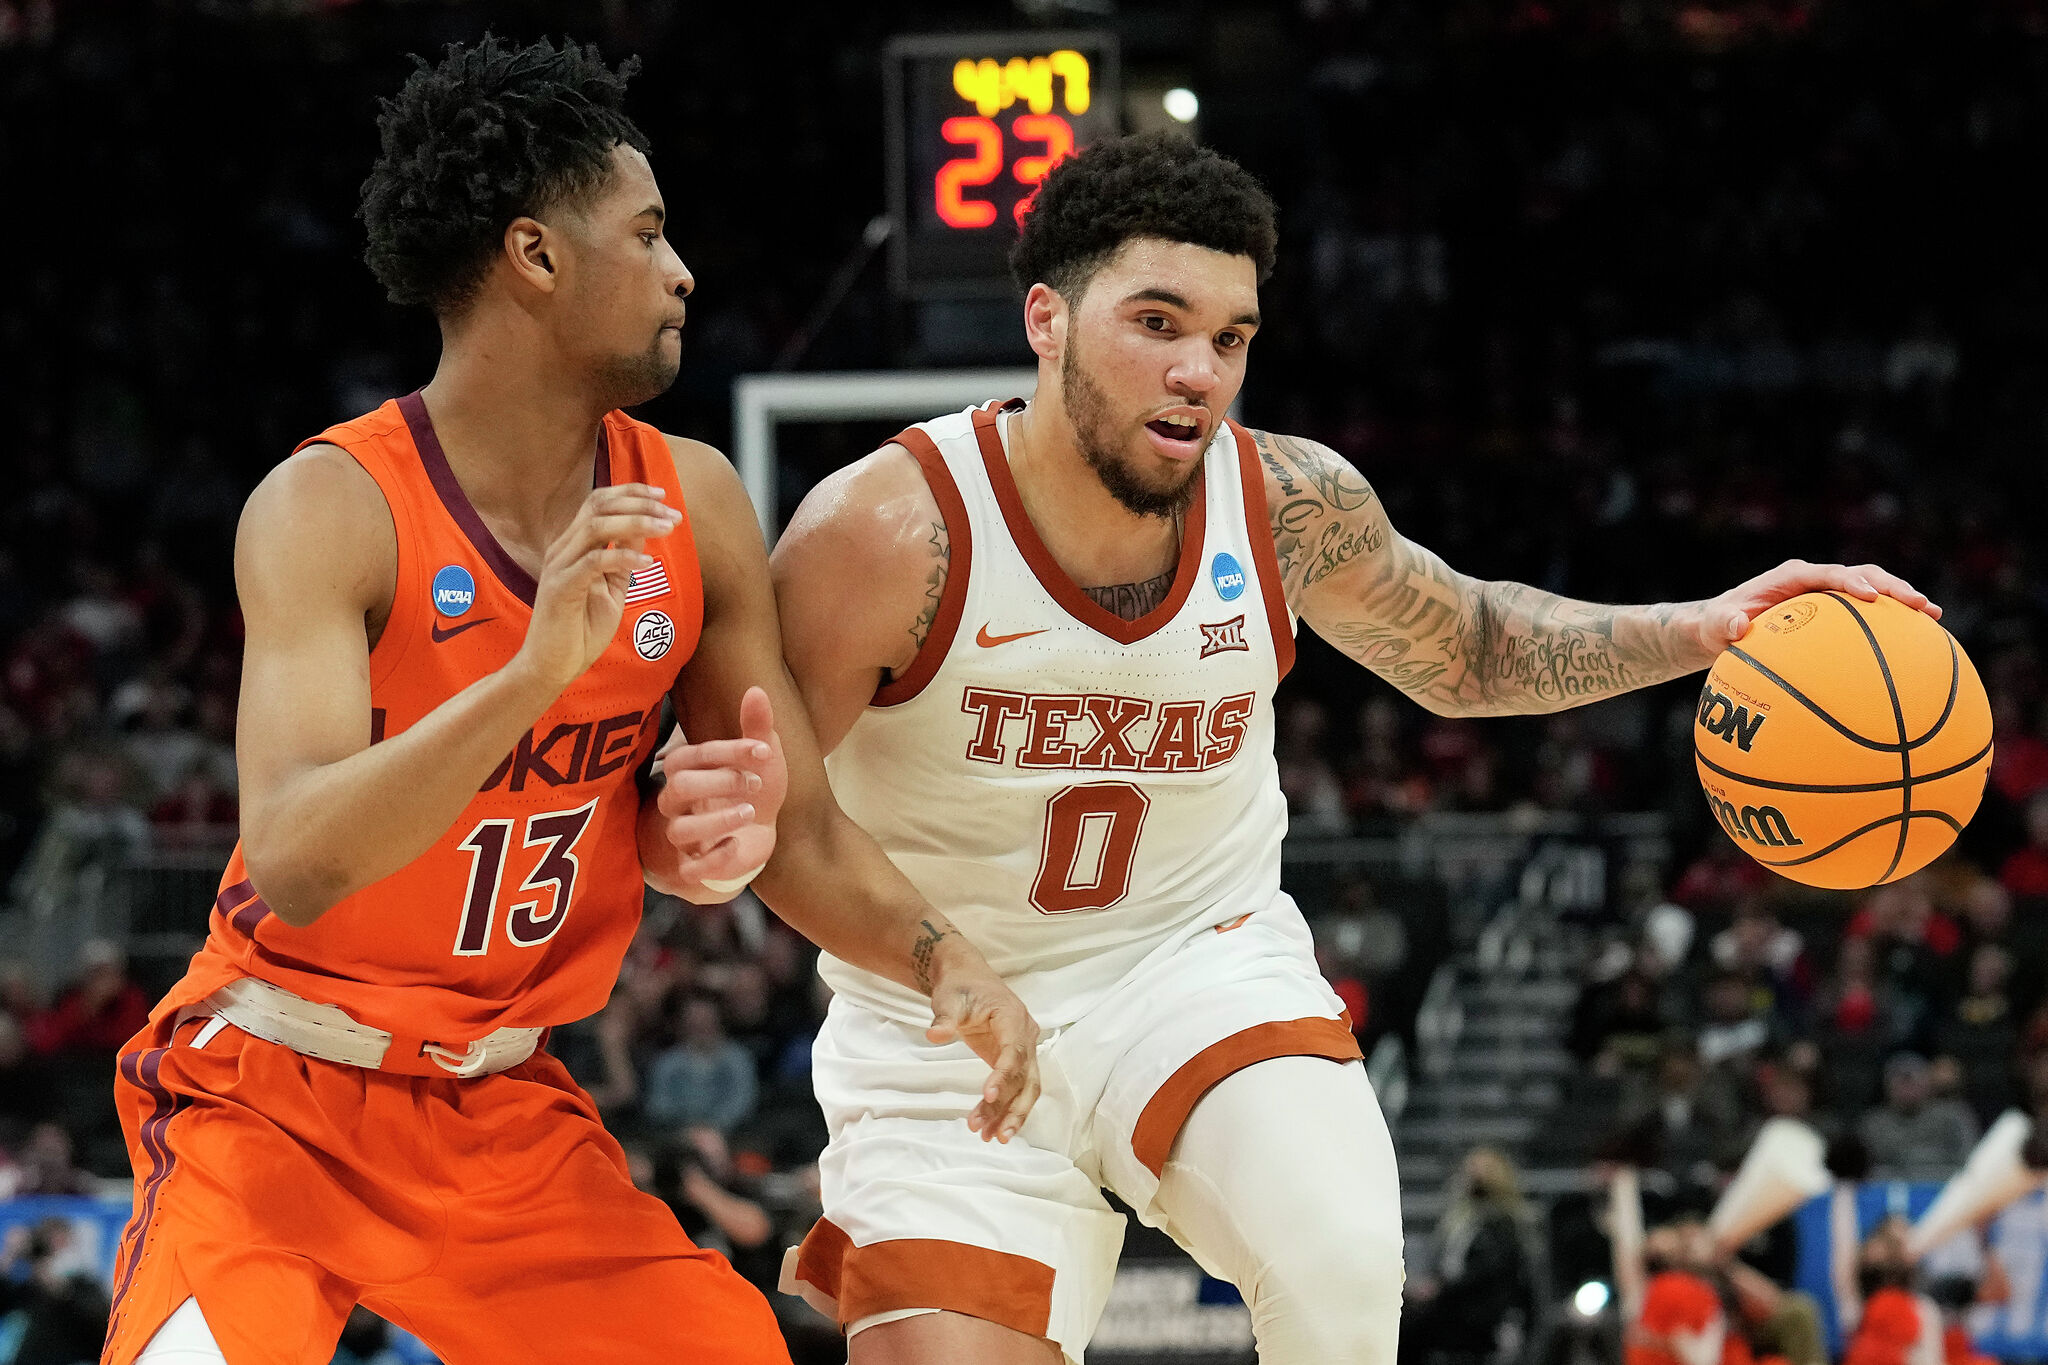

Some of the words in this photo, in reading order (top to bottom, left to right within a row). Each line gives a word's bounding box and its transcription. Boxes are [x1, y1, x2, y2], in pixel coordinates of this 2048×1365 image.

[953, 50, 1090, 117] 4:47
[437, 588, 473, 604] NCAA
[1217, 572, 1244, 589] NCAA
[641, 624, 670, 642] ACC
[1202, 617, 1248, 656] XII
[1697, 684, 1766, 753] NCA
[1731, 686, 1772, 712] OFFICIAL
[961, 686, 1256, 772] TEXAS
[1028, 780, 1151, 915] 0
[452, 796, 600, 957] 13
